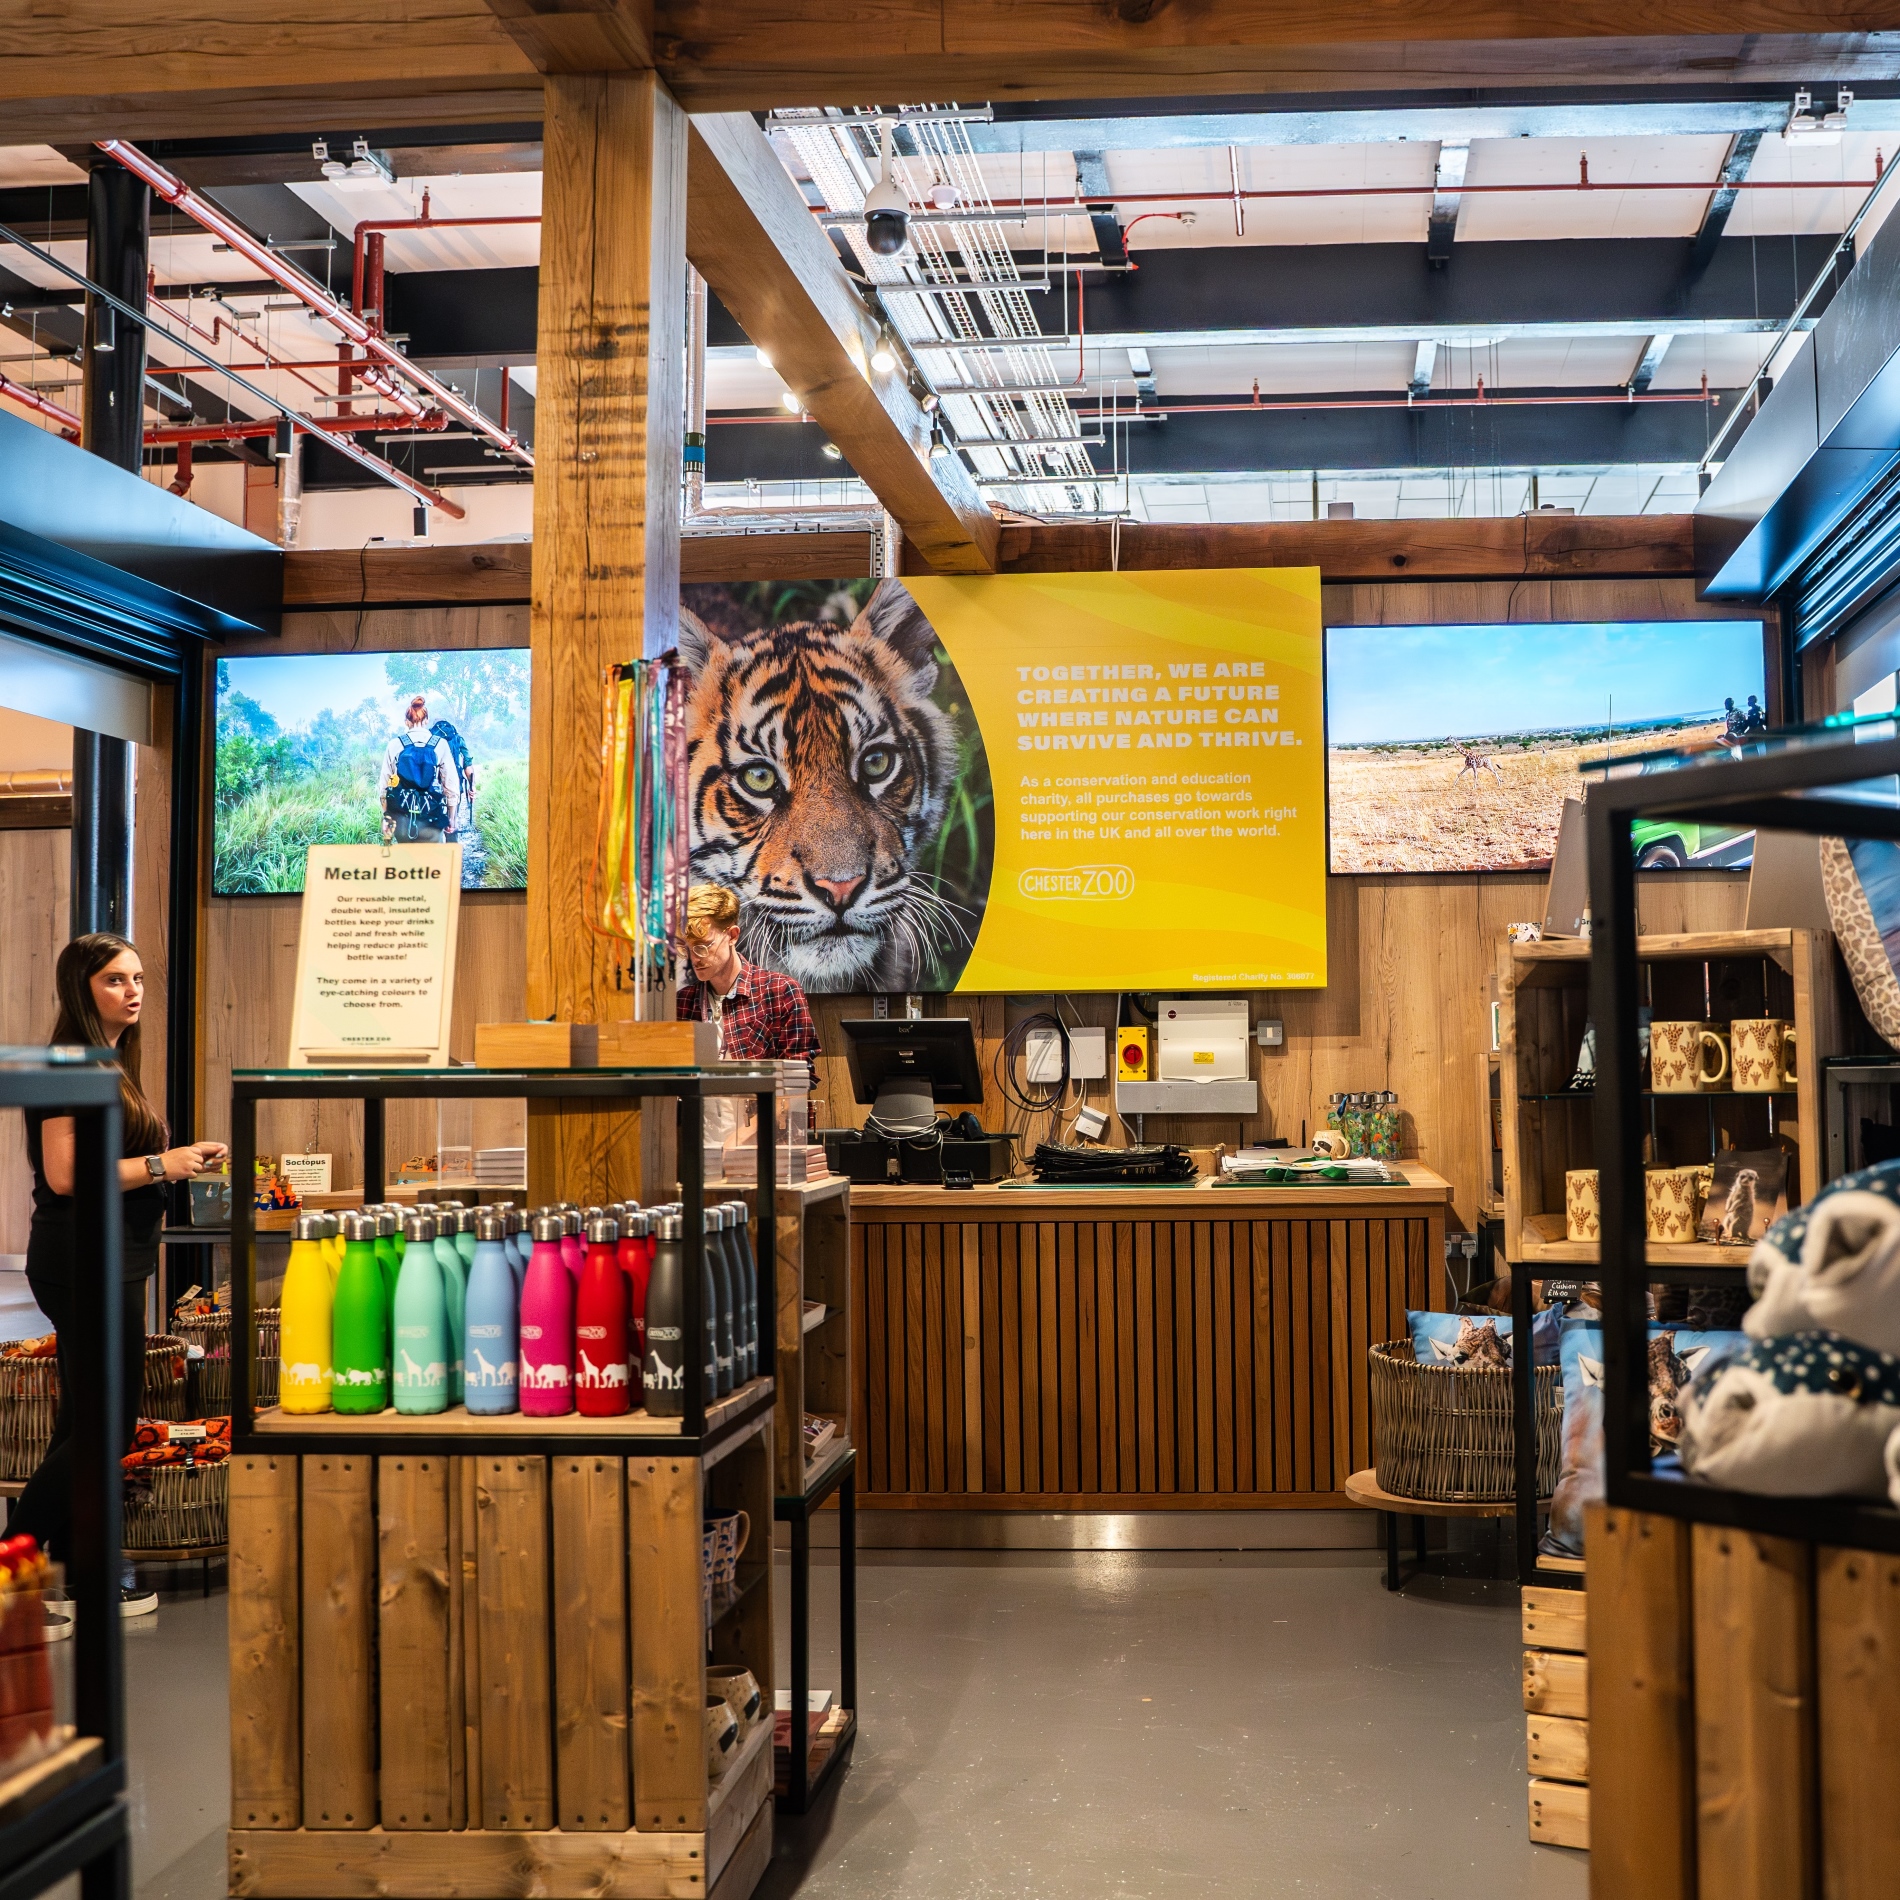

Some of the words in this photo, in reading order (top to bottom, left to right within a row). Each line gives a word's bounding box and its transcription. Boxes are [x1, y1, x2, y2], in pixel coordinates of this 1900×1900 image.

[1016, 664, 1161, 681] TOGETHER,
[1168, 663, 1207, 678] WE
[1213, 662, 1265, 677] ARE
[1017, 687, 1148, 704] CREATING
[1154, 686, 1172, 702] A
[1178, 685, 1280, 701] FUTURE
[1017, 711, 1108, 727] WHERE
[1115, 709, 1218, 726] NATURE
[1224, 708, 1278, 724] CAN
[1017, 734, 1131, 750] SURVIVE
[1137, 732, 1192, 748] AND
[1199, 731, 1303, 747] THRIVE.
[1020, 775, 1039, 787] As
[1043, 778, 1051, 787] a
[1055, 774, 1147, 787] conservation
[1151, 773, 1177, 785] and
[1181, 772, 1251, 784] education
[1020, 793, 1072, 807] charity,
[1076, 792, 1092, 804] all
[1096, 791, 1169, 806] purchases
[1174, 793, 1192, 805] go
[1196, 790, 1253, 802] towards
[1020, 810, 1097, 825] supporting
[1101, 811, 1125, 821] our
[1129, 808, 1221, 821] conservation
[1225, 807, 1260, 819] work
[1264, 806, 1297, 821] right
[1020, 828, 1052, 840] here
[1056, 828, 1069, 840] in
[1073, 827, 1095, 839] the
[1099, 827, 1121, 839] UK
[1124, 827, 1151, 839] and
[1155, 826, 1171, 838] all
[1175, 827, 1207, 837] over
[1211, 825, 1233, 837] the
[1237, 825, 1281, 837] world.
[324, 867, 377, 881] Metal
[384, 866, 441, 880] Bottle
[1024, 875, 1082, 892] CHESTER
[1081, 870, 1127, 896] ZOO
[337, 895, 353, 903] Our
[356, 895, 395, 903] reusable
[397, 895, 426, 903] metal,
[324, 918, 356, 926] bottles
[359, 919, 381, 927] keep
[384, 919, 404, 927] your
[406, 918, 434, 926] drinks
[327, 942, 361, 950] helping
[397, 942, 429, 950] plastic
[316, 977, 339, 985] They
[389, 977, 421, 985] variety
[1192, 974, 1237, 983] Registered
[1238, 973, 1268, 983] Charity
[320, 989, 379, 997] eye-catching
